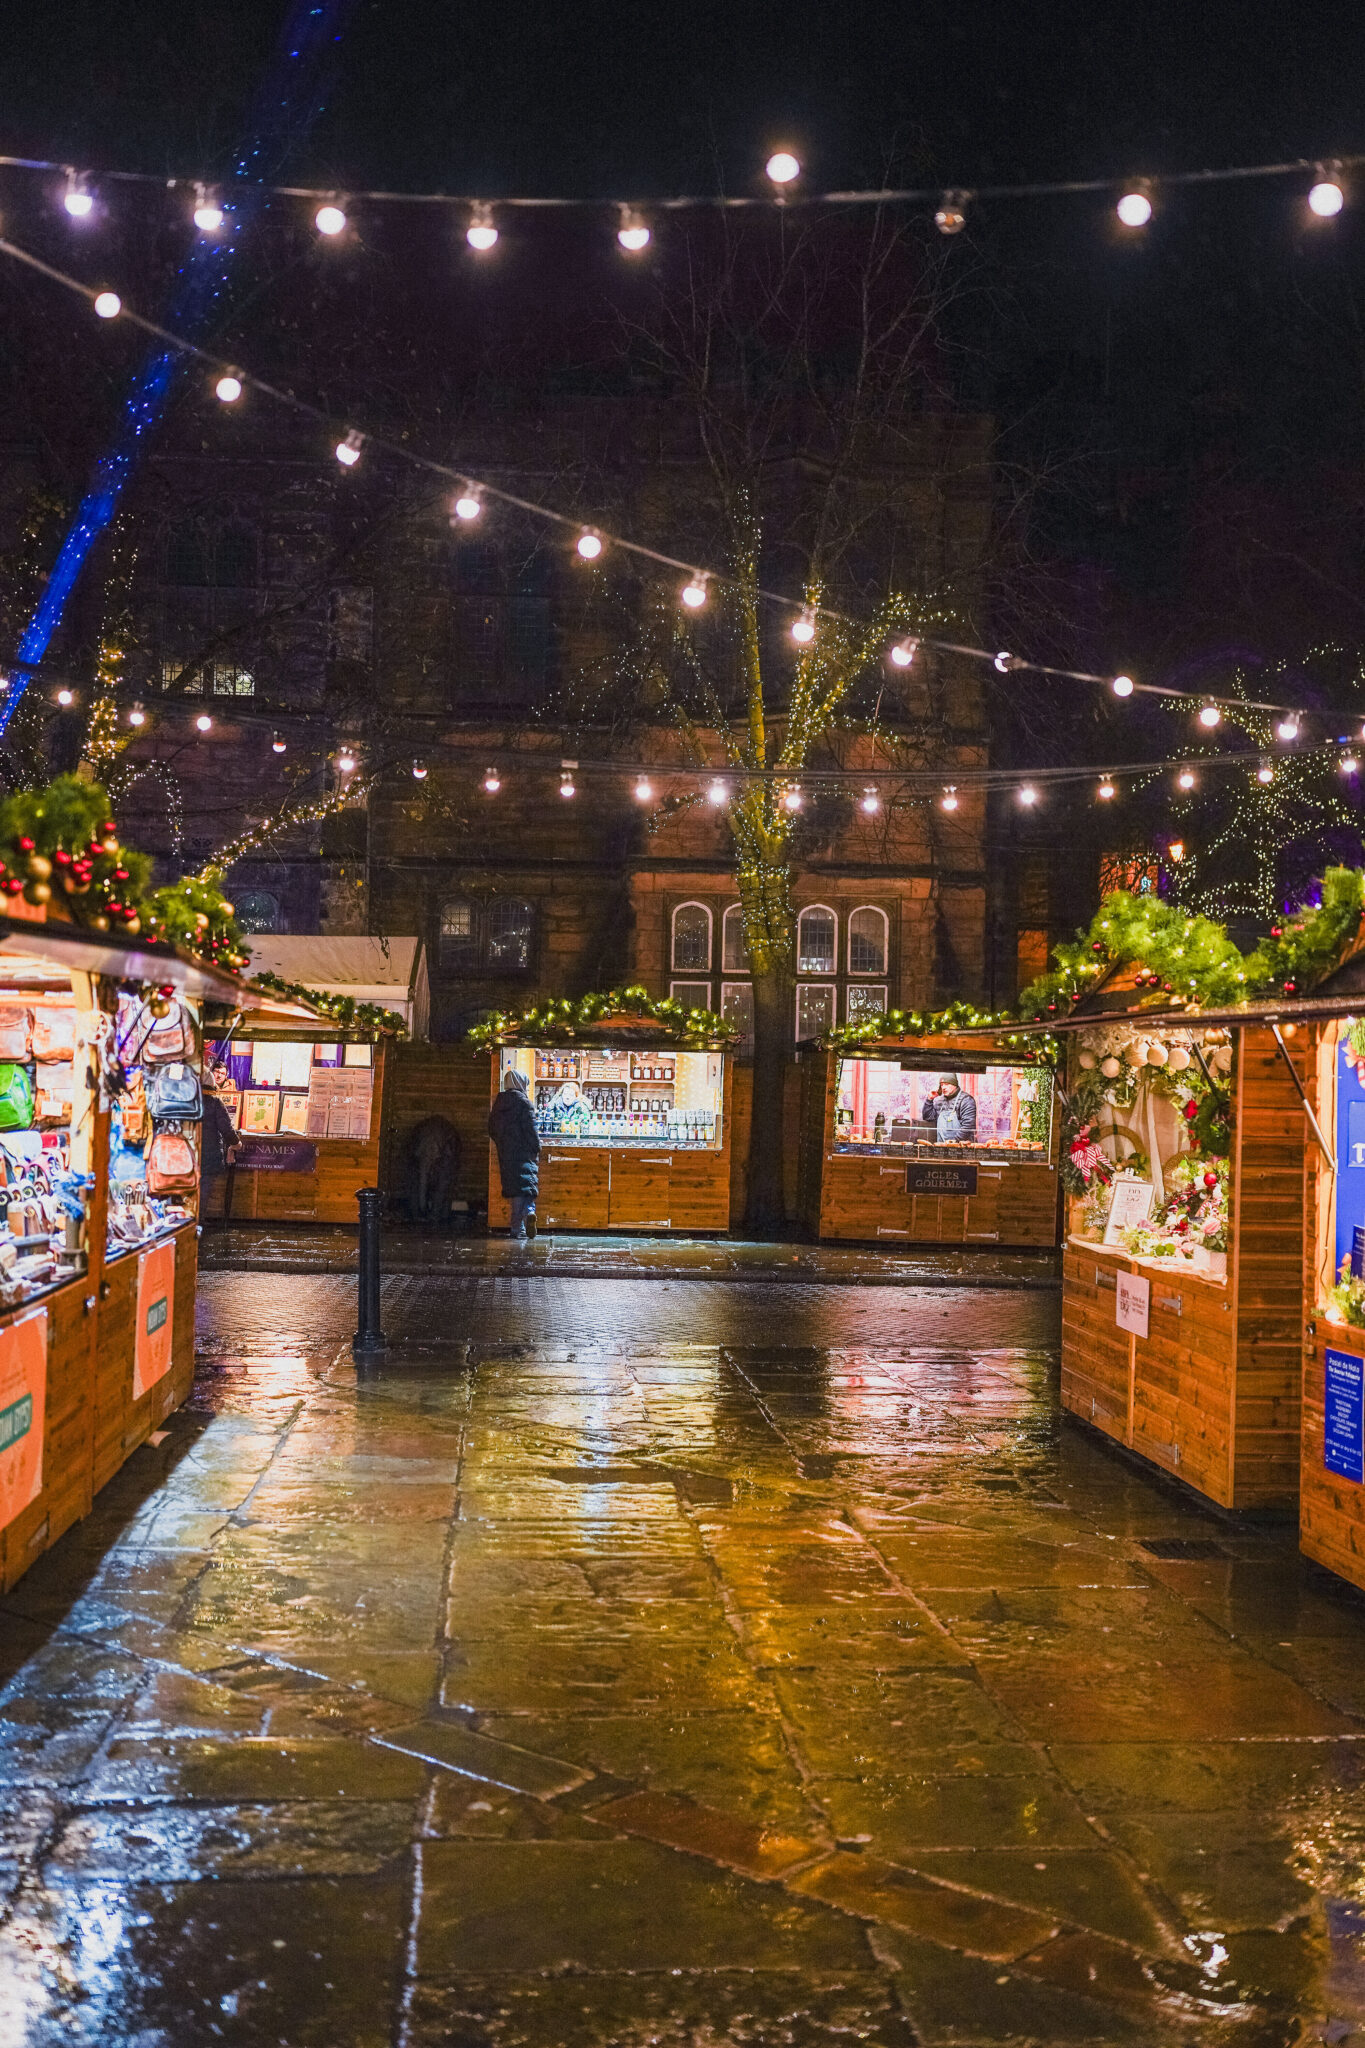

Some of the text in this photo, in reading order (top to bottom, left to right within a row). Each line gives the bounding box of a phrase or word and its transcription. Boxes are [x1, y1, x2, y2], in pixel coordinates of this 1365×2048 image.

[256, 1144, 296, 1155] NAMES
[916, 1180, 969, 1188] GOURMET
[1342, 1361, 1347, 1369] de
[1348, 1363, 1359, 1373] Nata
[1329, 1414, 1356, 1428] CHOCOLATE ORANGE
